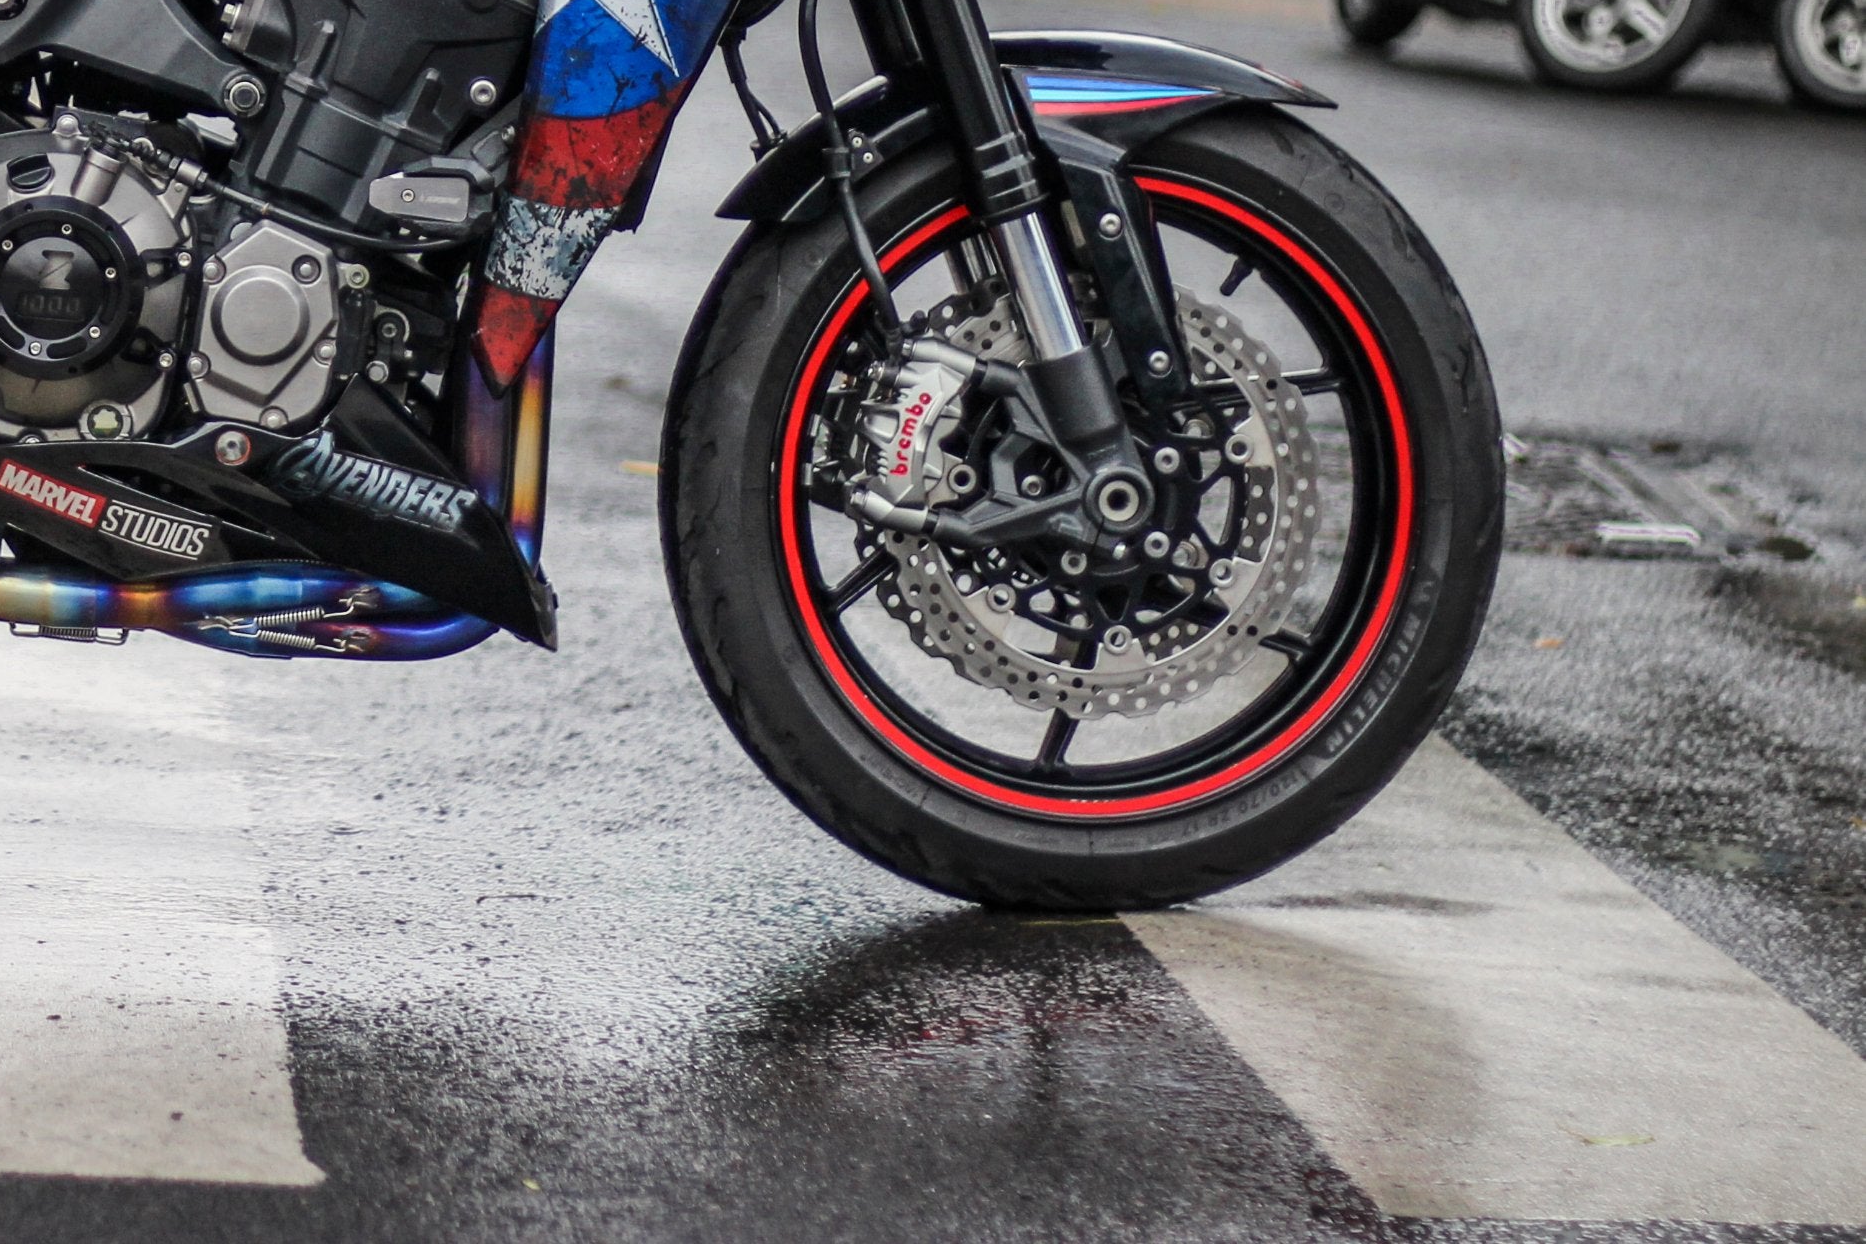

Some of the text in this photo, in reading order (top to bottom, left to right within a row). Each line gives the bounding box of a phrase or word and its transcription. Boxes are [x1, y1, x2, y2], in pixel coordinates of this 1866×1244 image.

[890, 392, 932, 476] brembo
[274, 430, 479, 532] AVENGERS
[100, 504, 210, 557] STUDIOS
[1324, 611, 1422, 754] MICHELIN
